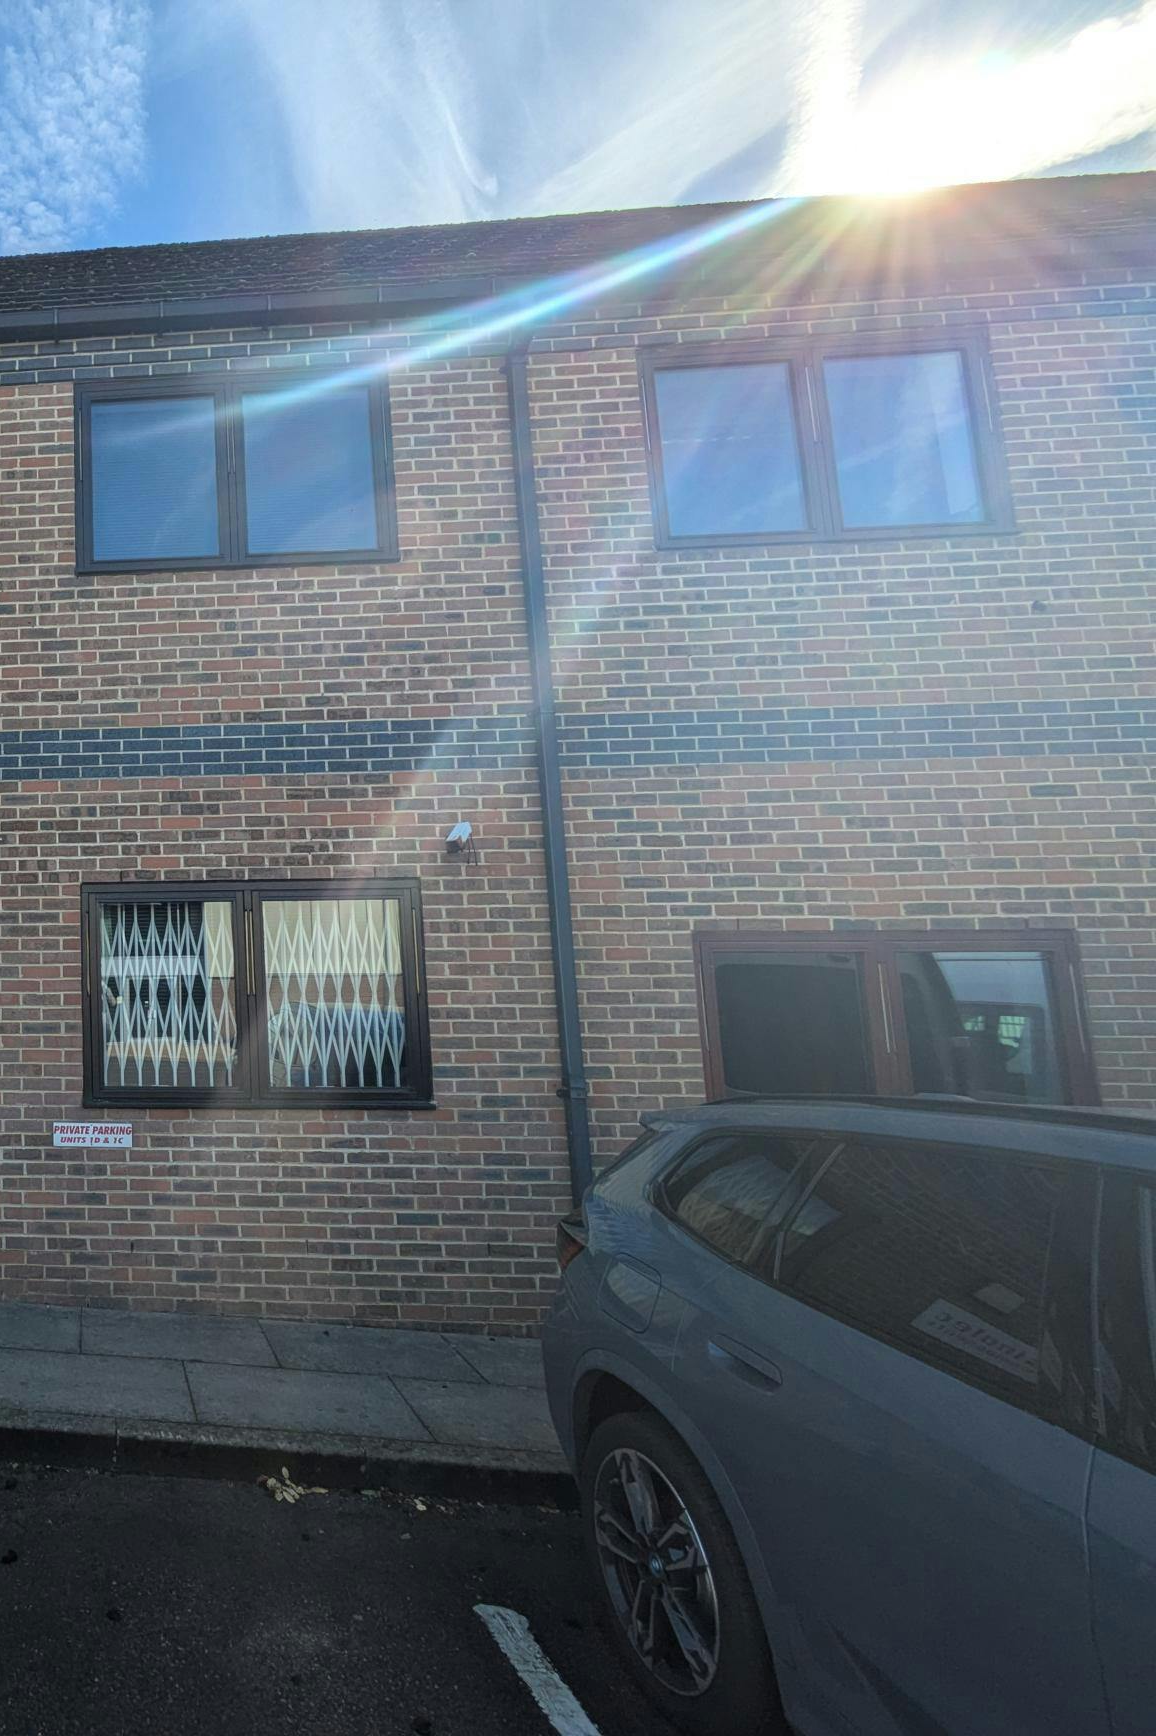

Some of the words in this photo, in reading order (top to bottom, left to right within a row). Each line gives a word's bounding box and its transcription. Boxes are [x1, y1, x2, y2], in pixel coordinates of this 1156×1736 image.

[53, 1125, 90, 1135] PRIVATE
[92, 1126, 132, 1135] PARKING
[90, 1136, 101, 1144] 1D
